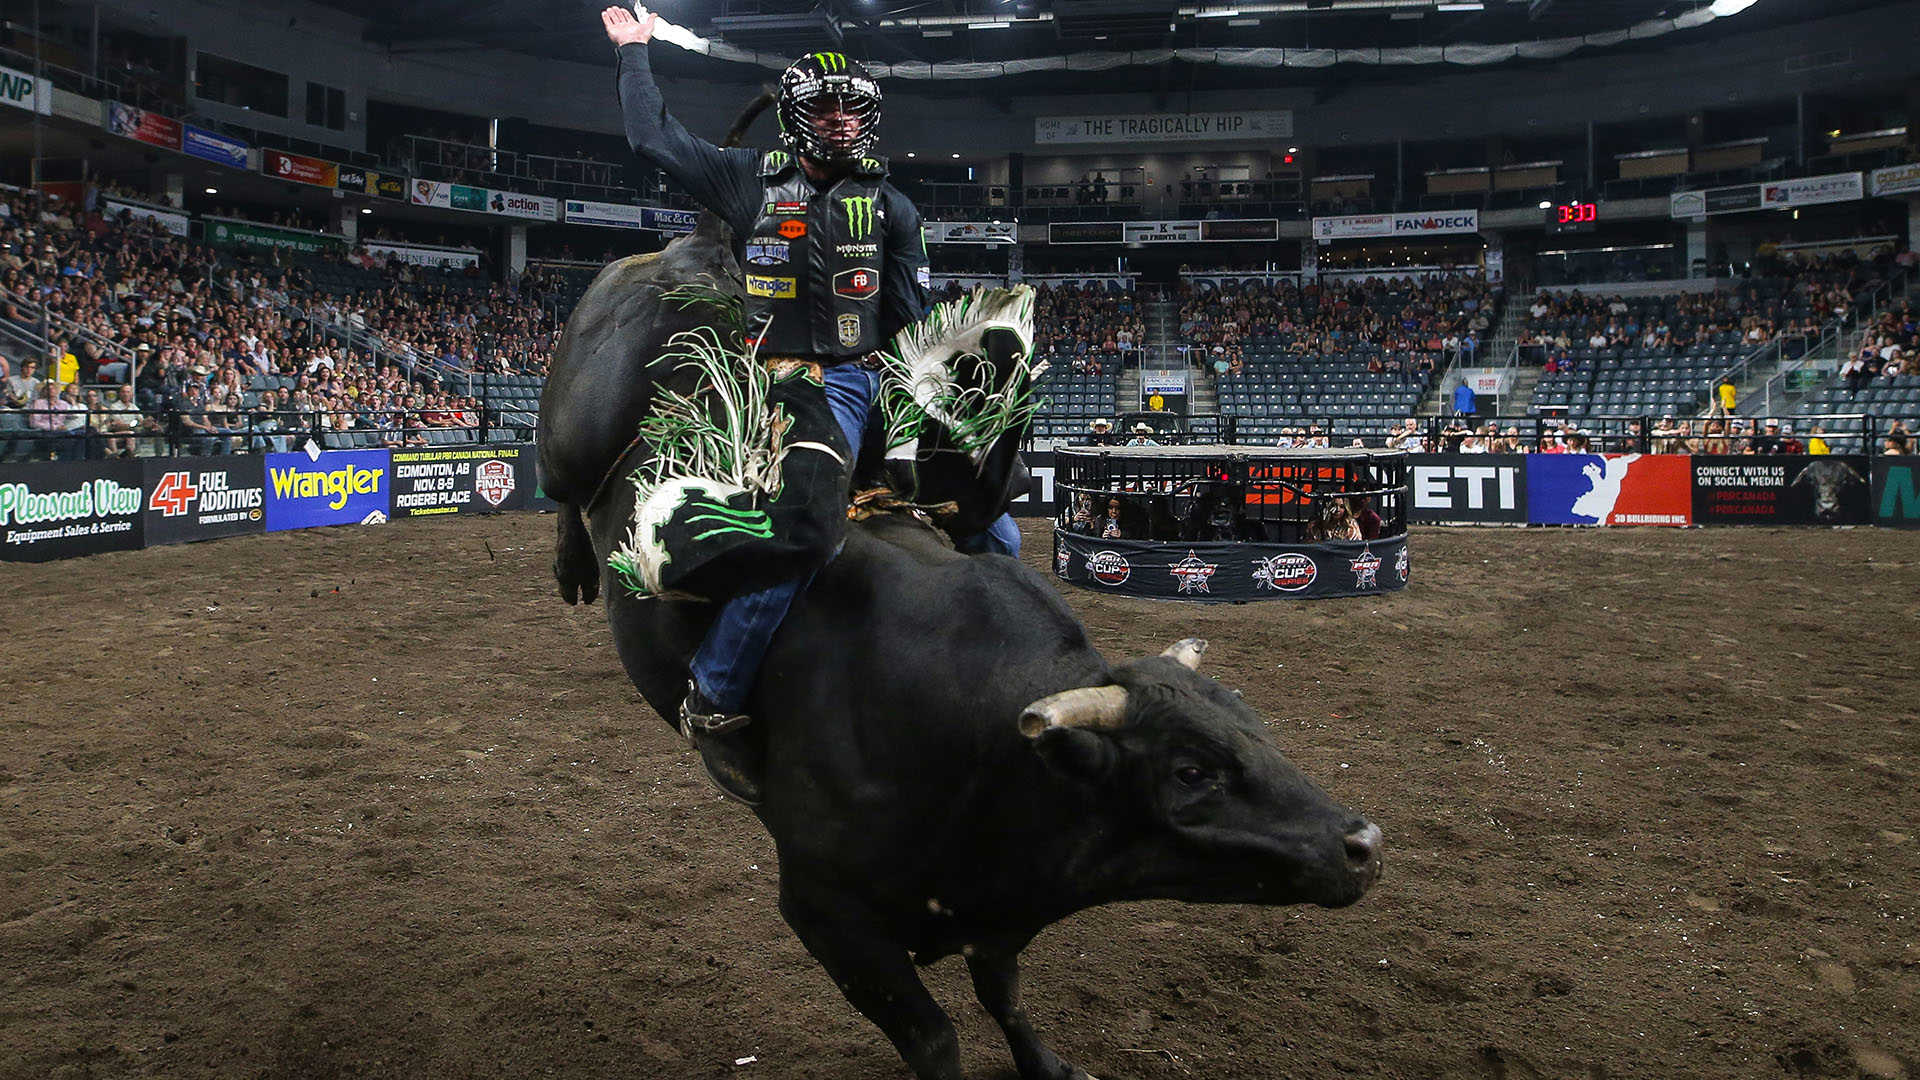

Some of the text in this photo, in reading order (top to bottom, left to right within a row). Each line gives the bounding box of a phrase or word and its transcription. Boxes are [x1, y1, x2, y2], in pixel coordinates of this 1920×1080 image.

[1084, 116, 1243, 136] THE TRAGICALLY HIP
[508, 199, 540, 212] action
[836, 243, 879, 253] MONSTER
[854, 274, 868, 287] FB
[749, 279, 793, 297] Wrangler
[393, 454, 419, 462] COMMAND
[419, 453, 442, 461] TUBULAR
[453, 451, 472, 459] CANADA
[472, 450, 497, 459] NATIONAL
[498, 450, 519, 458] FINALS
[397, 464, 455, 479] EDMONTON,
[455, 463, 470, 475] AB
[1697, 466, 1785, 476] CONNECT WITH US
[199, 472, 229, 493] FUEL
[270, 464, 384, 511] Wrangler
[413, 478, 455, 492] NOV. 8-9
[475, 478, 516, 493] FINALS
[1698, 477, 1784, 486] ON SOCIAL MEDIA!
[0, 479, 142, 526] Pleasant View
[199, 487, 262, 513] ADDITIVES
[397, 490, 471, 508] ROGERS PLACE
[199, 512, 248, 525] FORMULATED BY
[6, 520, 132, 545] Equipment Sales & Service
[1095, 564, 1119, 574] CUP
[1274, 568, 1306, 579] CUP
